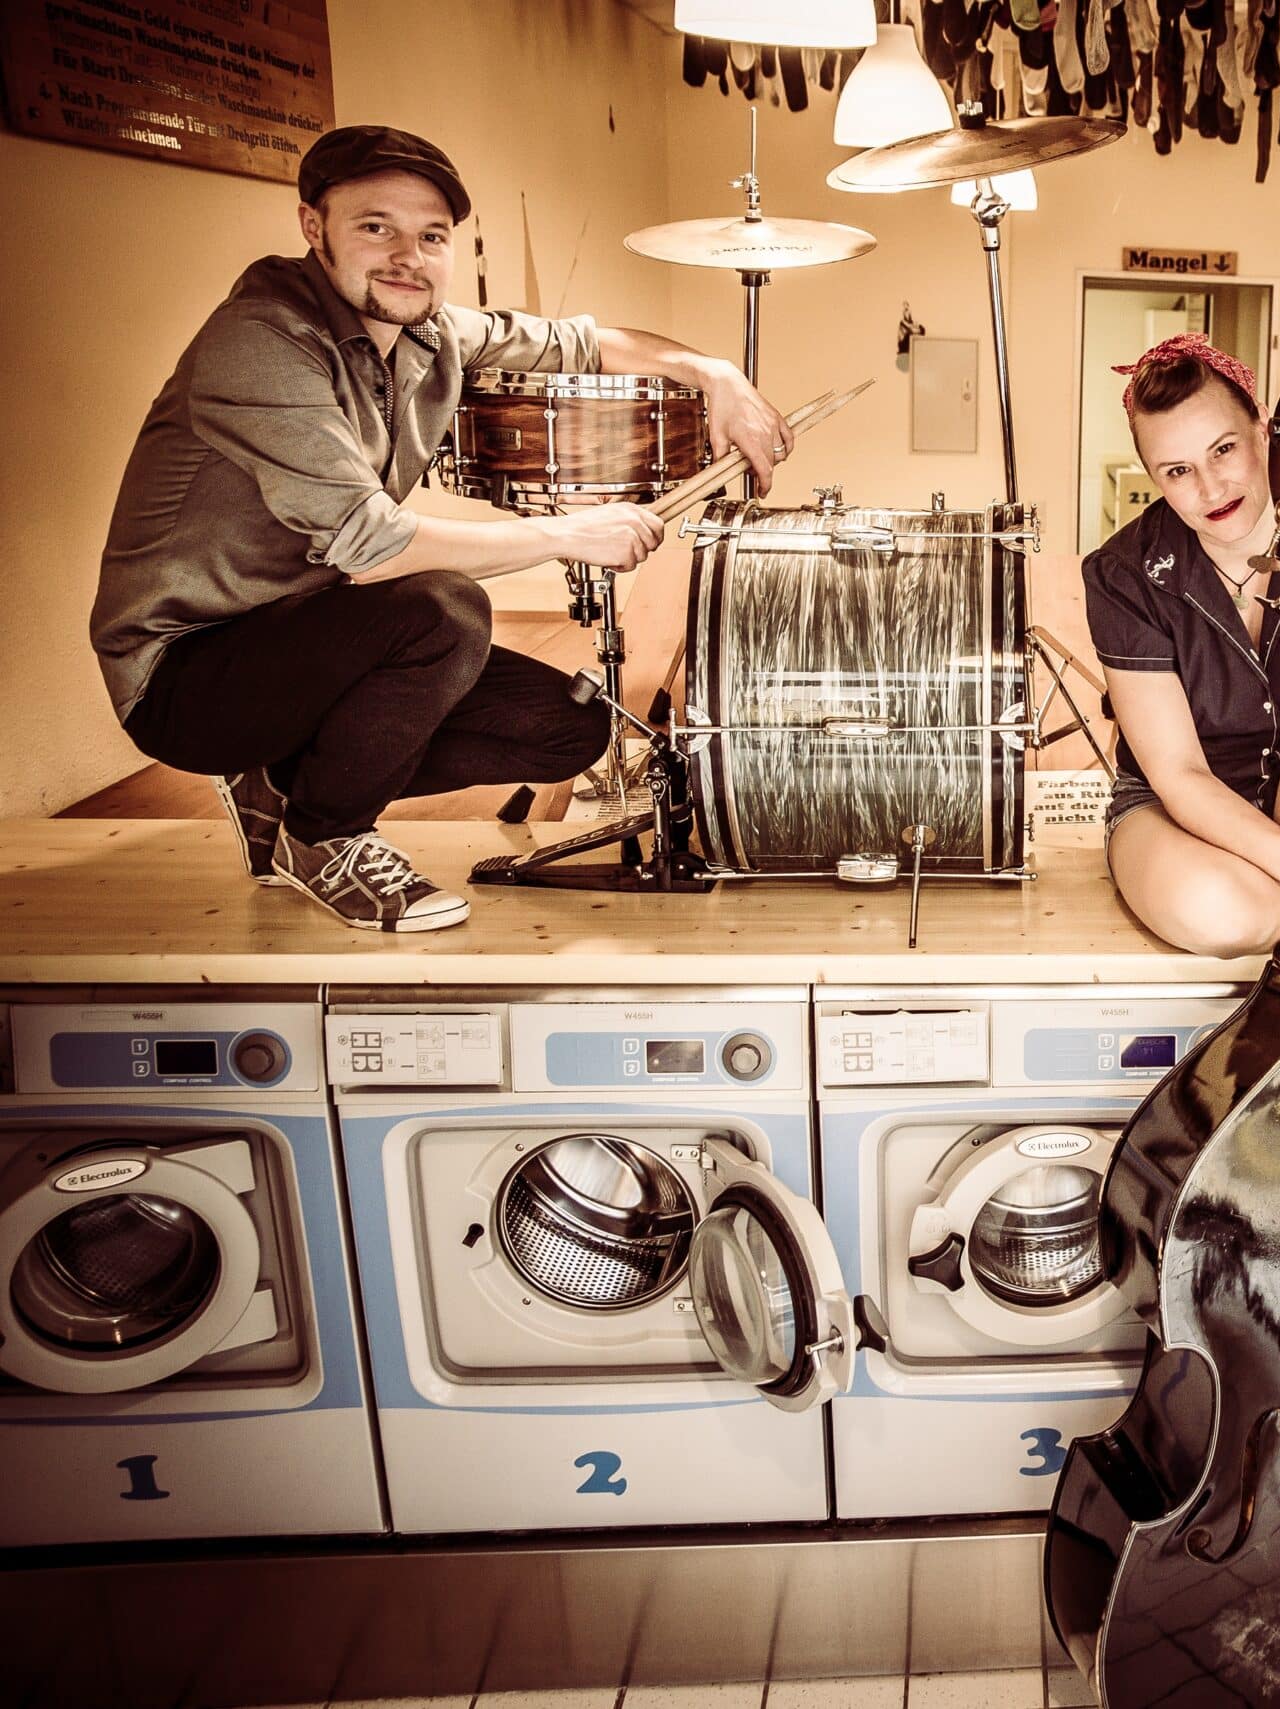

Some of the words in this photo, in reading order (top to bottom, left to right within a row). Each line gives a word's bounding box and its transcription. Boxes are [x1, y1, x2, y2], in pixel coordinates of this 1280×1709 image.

[227, 40, 247, 57] und
[81, 56, 116, 80] Start
[57, 81, 93, 108] Nach
[187, 112, 206, 135] Tür
[1129, 251, 1207, 272] Mangel
[1129, 492, 1151, 504] 21
[1037, 780, 1101, 789] Farben
[1034, 802, 1065, 811] auf
[1070, 802, 1099, 810] die
[1044, 814, 1096, 823] nicht
[137, 1043, 143, 1051] 1
[627, 1042, 633, 1051] 1
[138, 1065, 145, 1073] 2
[628, 1064, 635, 1073] 2
[1038, 1141, 1080, 1151] Electrolux
[80, 1166, 132, 1183] Electrolux
[1019, 1427, 1067, 1476] 3
[116, 1454, 170, 1501] 1
[574, 1450, 627, 1496] 2
